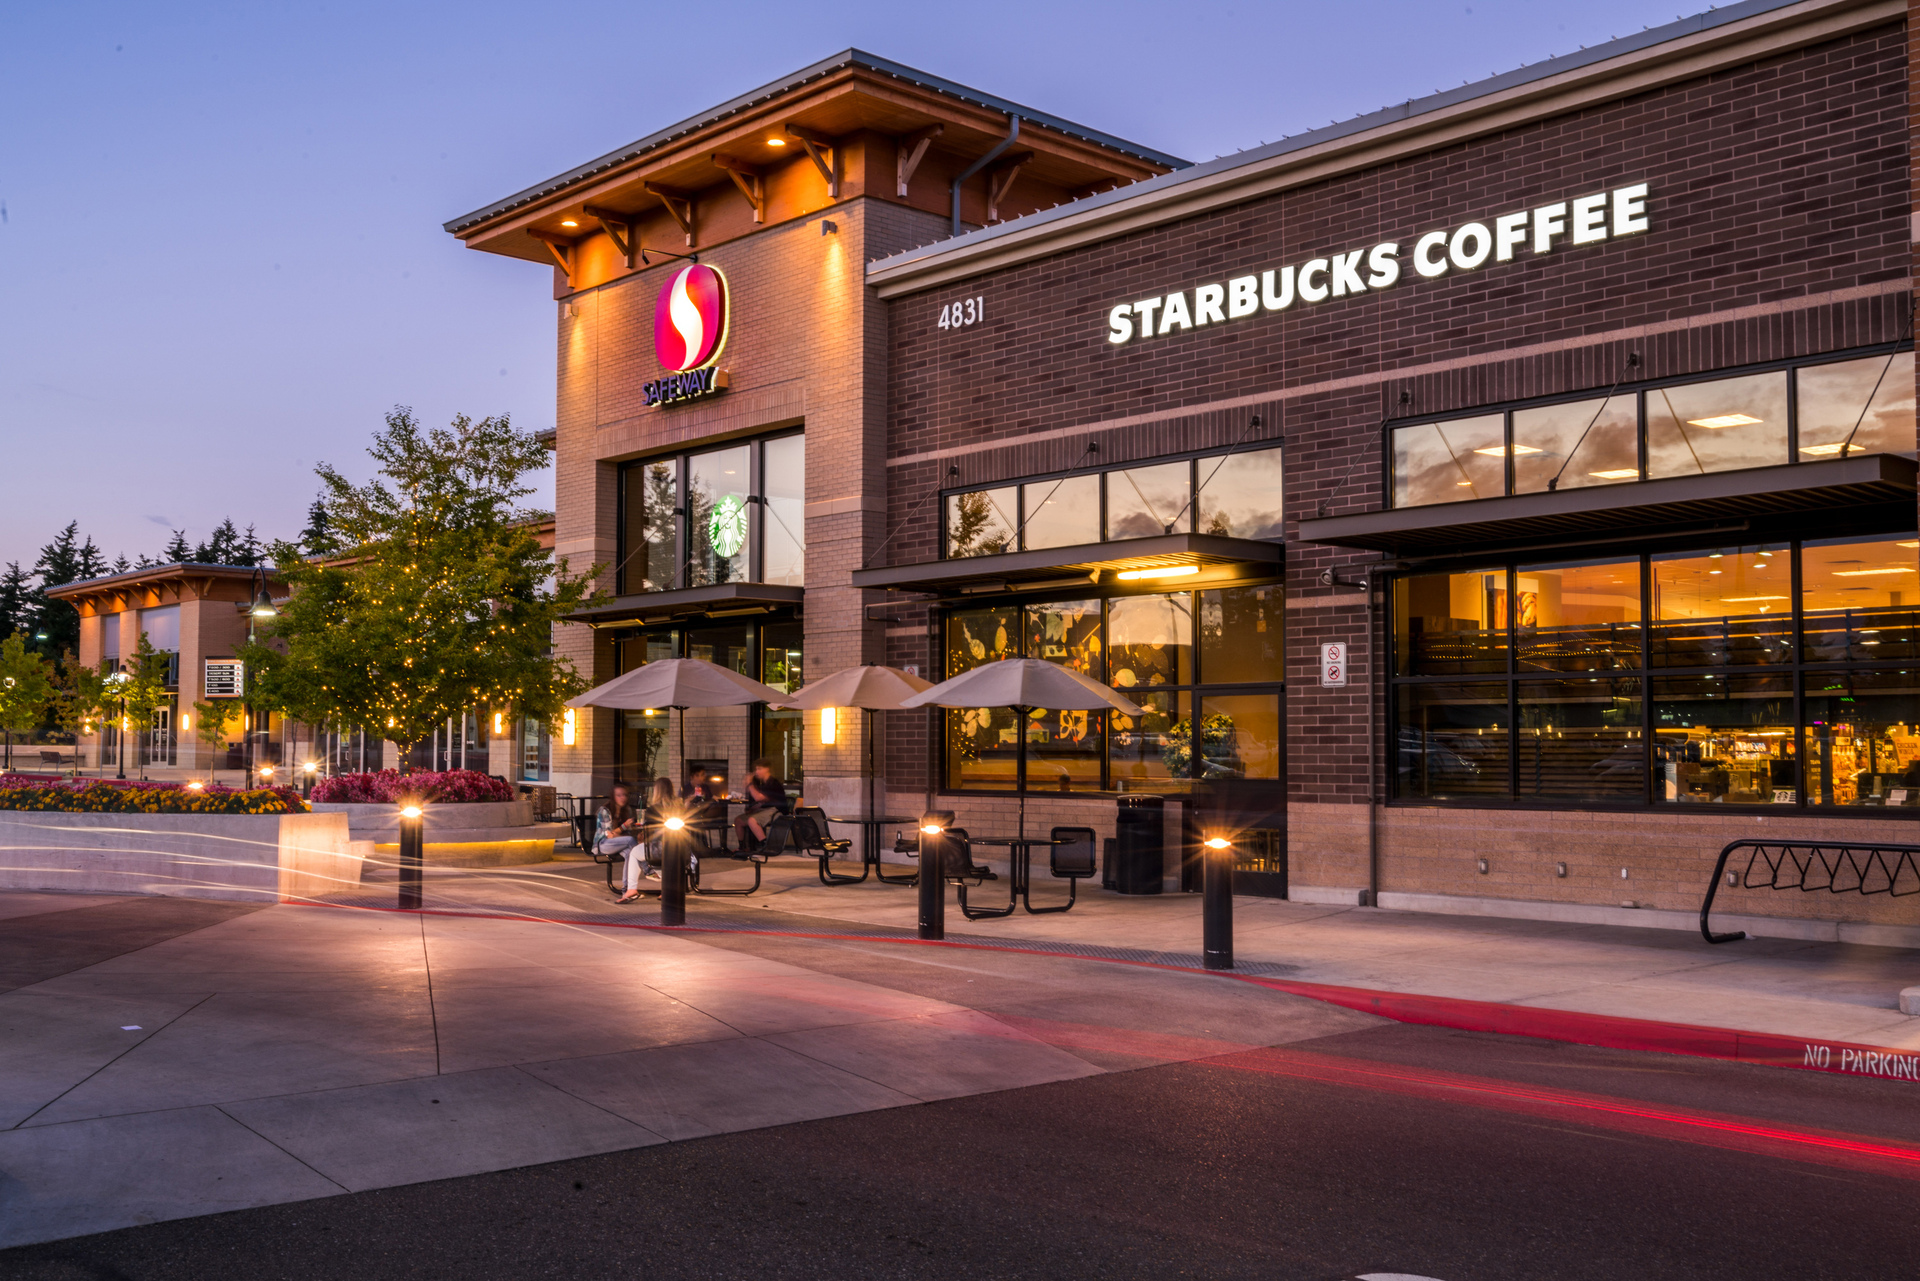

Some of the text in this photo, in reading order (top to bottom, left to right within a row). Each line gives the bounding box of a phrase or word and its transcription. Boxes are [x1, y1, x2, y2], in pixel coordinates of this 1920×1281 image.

[1107, 182, 1649, 345] STARBUCKS COFFEE
[937, 295, 984, 330] 4831
[641, 366, 713, 406] SAFEWAY
[1804, 1044, 1830, 1068] NO
